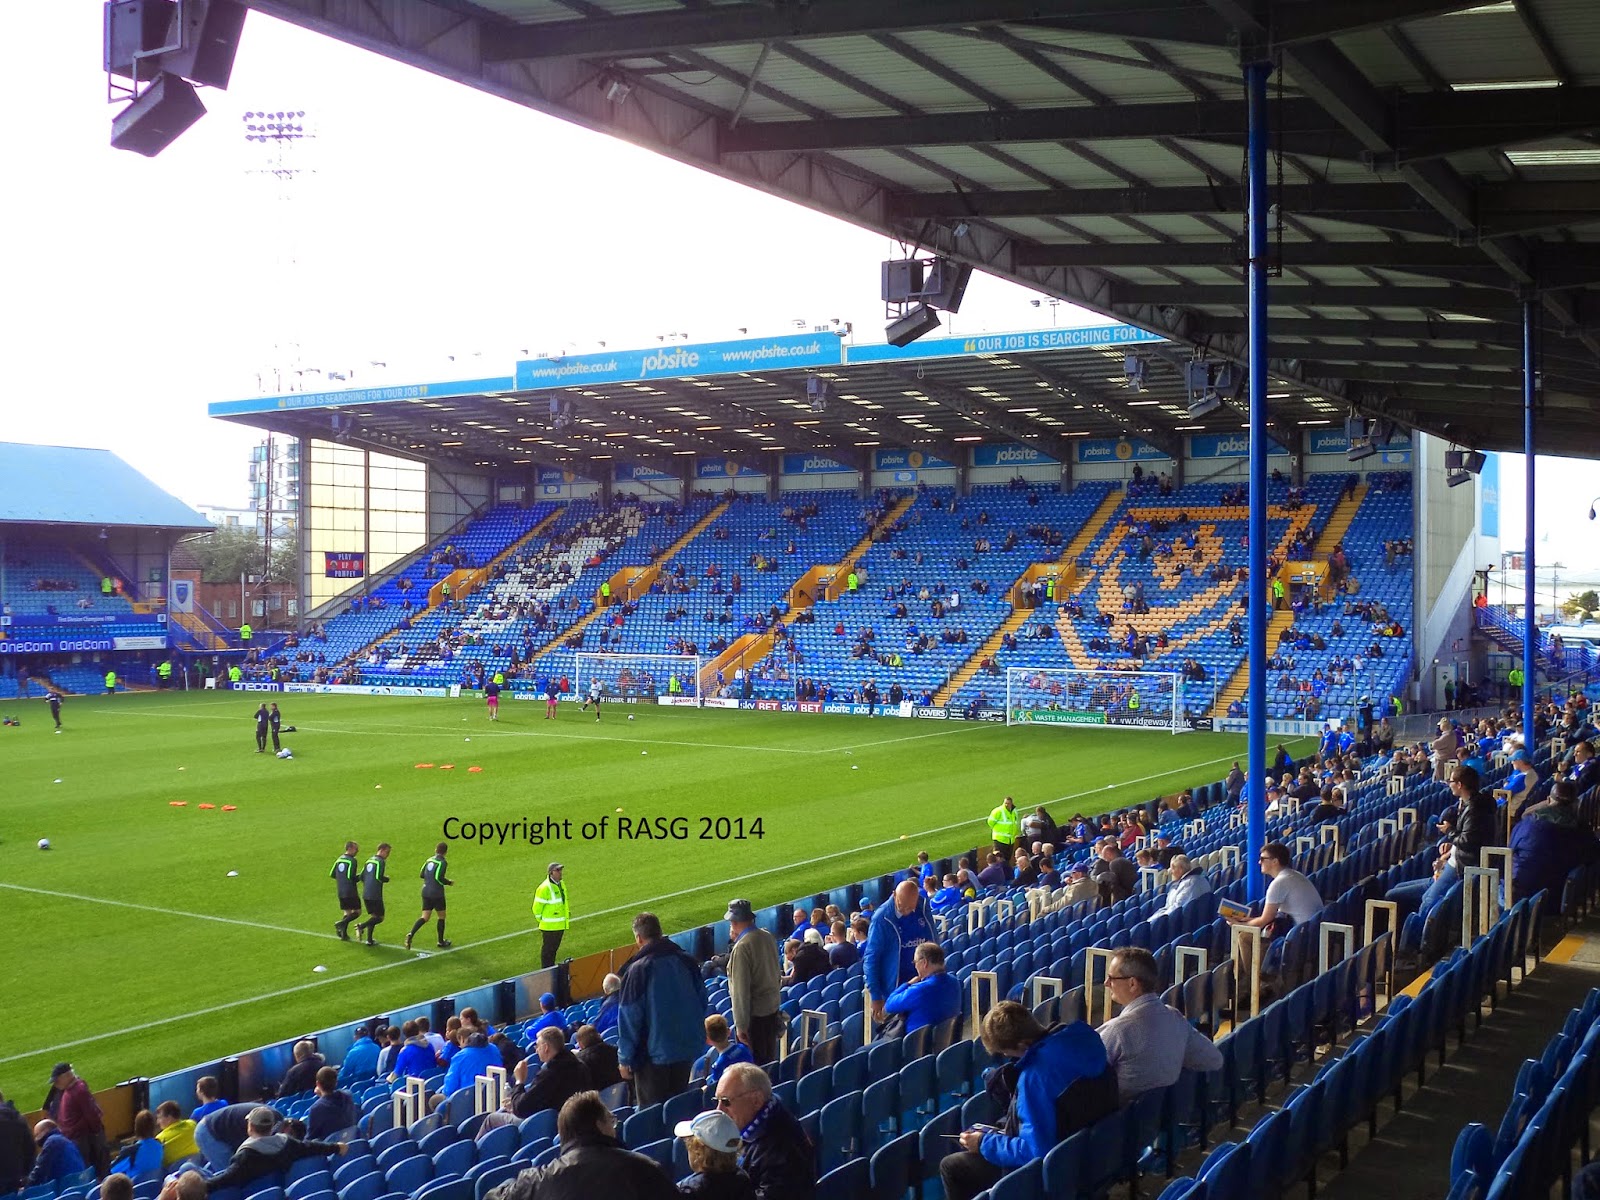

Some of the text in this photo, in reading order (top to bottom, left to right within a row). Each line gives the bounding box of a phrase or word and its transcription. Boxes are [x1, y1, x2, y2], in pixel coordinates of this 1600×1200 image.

[978, 337, 1002, 351] OUR
[1004, 334, 1025, 349] JOB
[1028, 334, 1040, 347] IS
[1042, 329, 1111, 346] SEARCHING
[1113, 328, 1137, 341] FOR
[722, 340, 821, 363] www.jobsite.co.uk
[640, 348, 699, 377] jobsite
[532, 359, 618, 380] www.jobsite.co.uk
[286, 386, 418, 407] OUR JOB IS SEARCHING FOR YOUR JOB
[1317, 436, 1347, 448] jobsite
[995, 446, 1038, 464] jobsite
[1084, 446, 1111, 458] jobsite
[881, 455, 904, 466] jobsite
[59, 639, 110, 651] OneCom
[233, 682, 279, 692] onecom
[781, 701, 821, 713] sky BET
[824, 703, 850, 713] jobsite
[919, 708, 946, 718] COVERS
[1034, 714, 1056, 722] WASTE
[1057, 715, 1102, 723] MANAGEMENT
